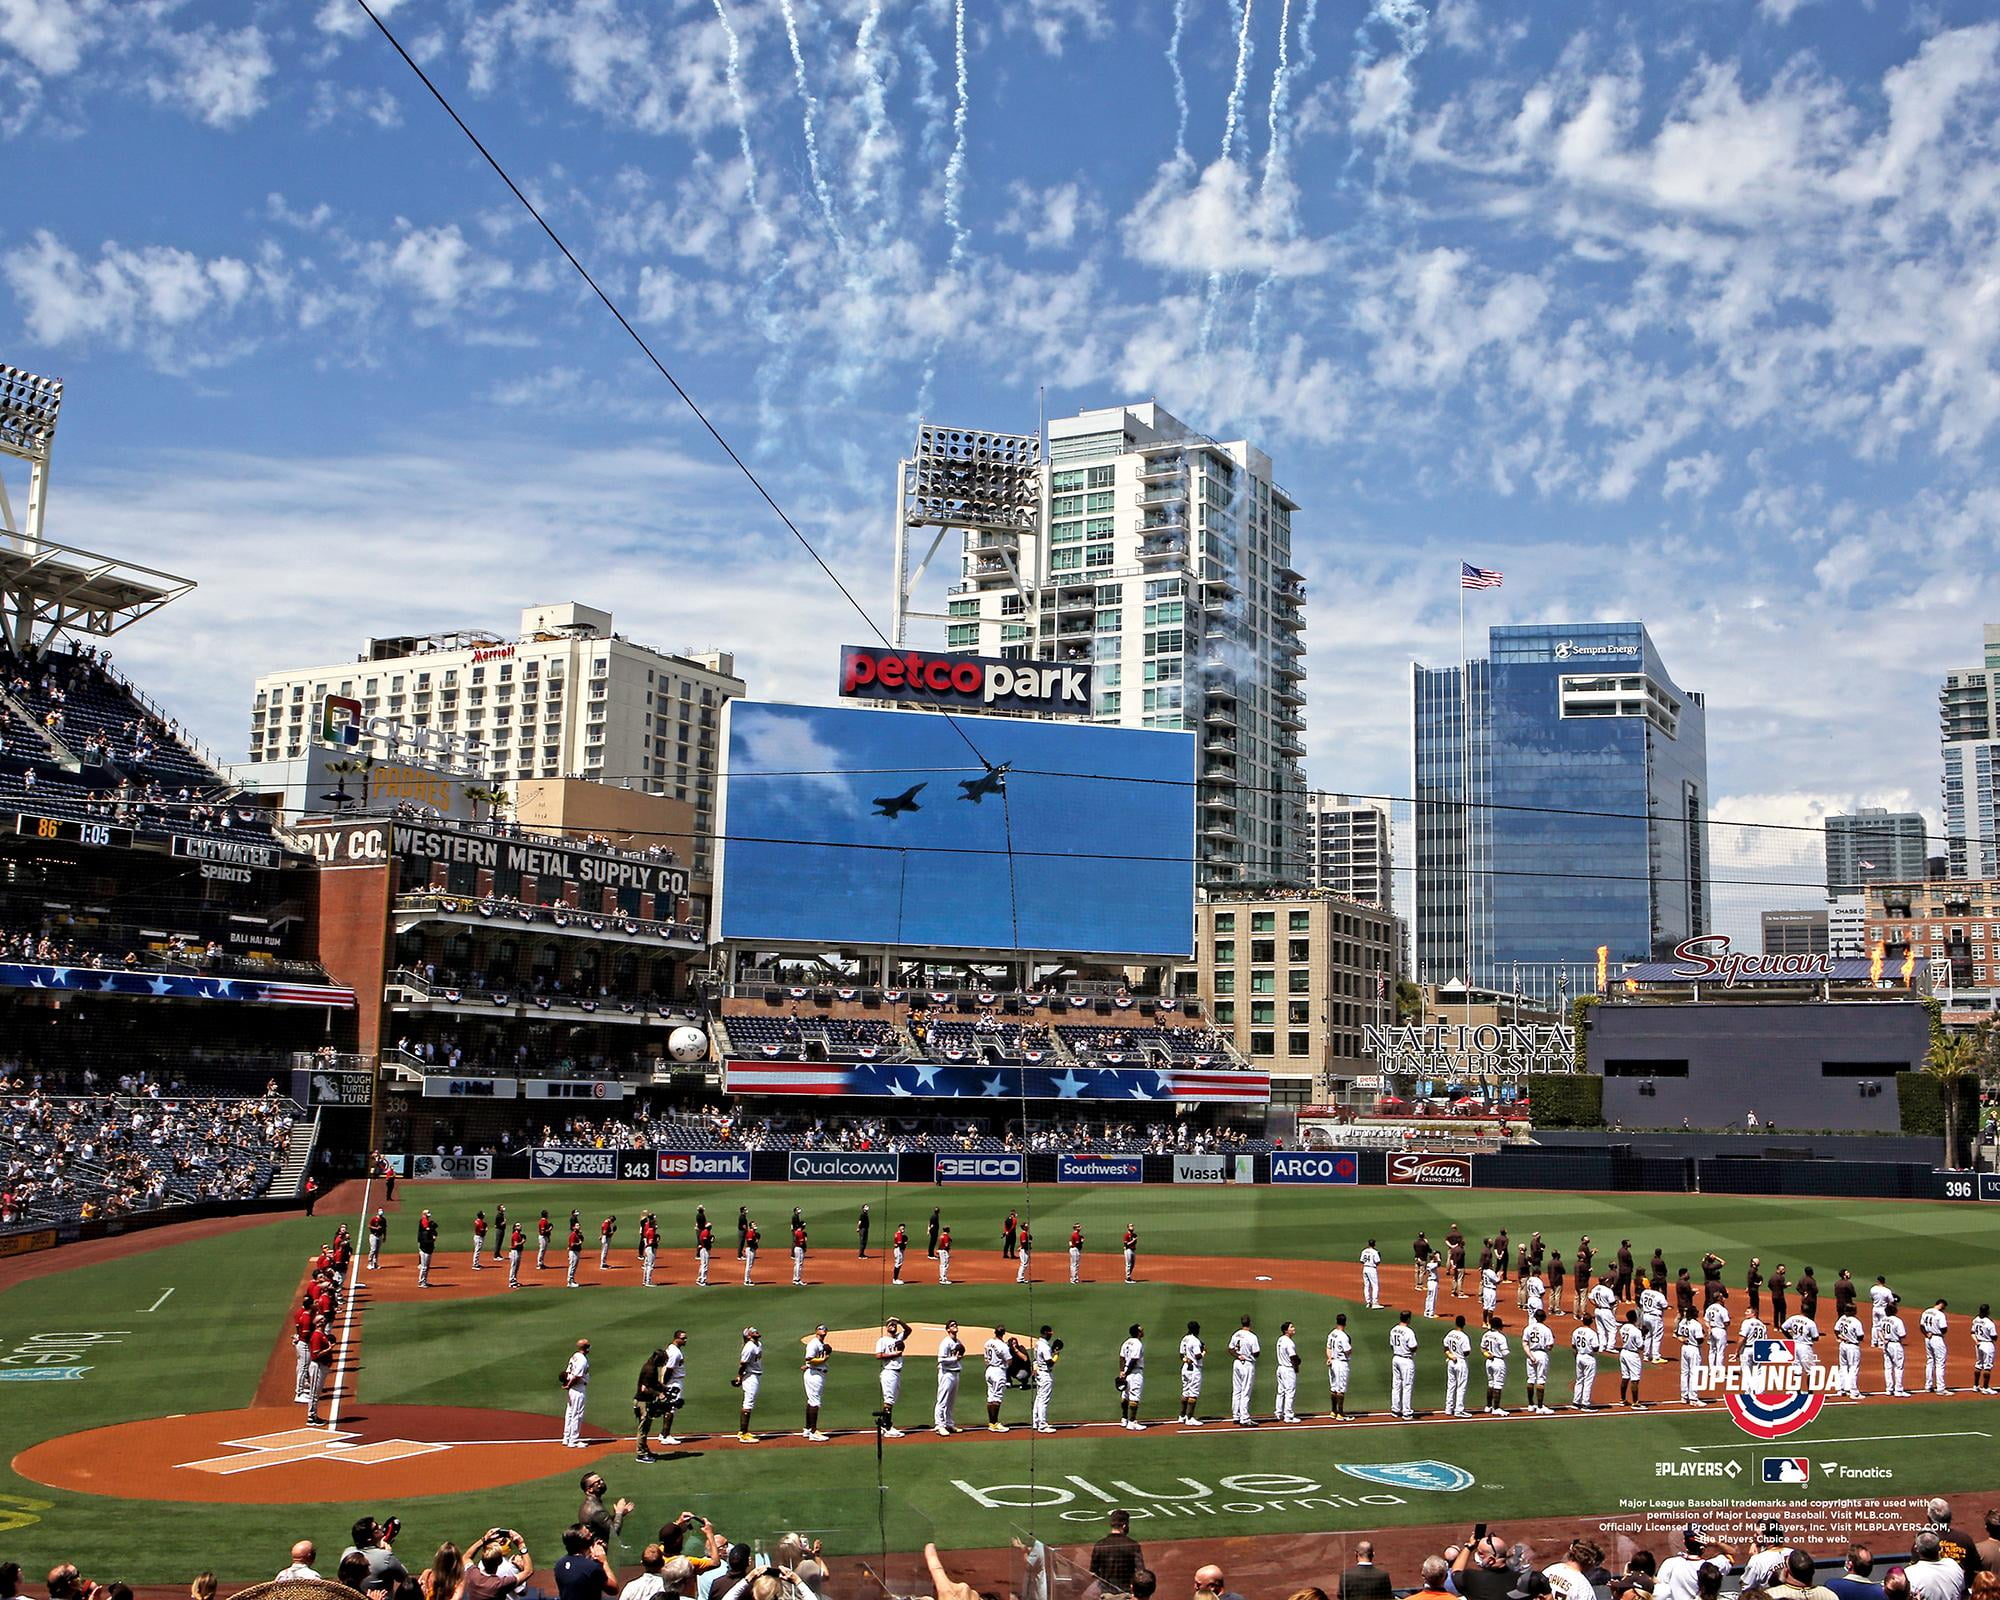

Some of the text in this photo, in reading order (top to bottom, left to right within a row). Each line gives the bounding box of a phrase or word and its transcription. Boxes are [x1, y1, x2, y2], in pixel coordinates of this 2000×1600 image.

[472, 646, 515, 663] Marriott
[1573, 645, 1639, 656] Sempra Energy
[372, 766, 450, 812] PADRES
[80, 823, 110, 845] 1:05
[186, 837, 271, 867] CUTWATER
[349, 829, 387, 861] CO.
[393, 826, 688, 896] WESTERN METAL SUPPLY CO.
[200, 864, 252, 884] SPIRITS
[230, 932, 248, 943] BALI
[264, 935, 281, 946] RUM
[1672, 934, 1835, 989] Sycuan
[1381, 1053, 1576, 1076] UNIVERSITY
[342, 1074, 372, 1085] TOUGH
[342, 1085, 371, 1094] TURTLE
[341, 1094, 370, 1103] TURF
[441, 1158, 488, 1171] ORIS
[564, 1154, 613, 1164] ROCKET
[794, 1158, 895, 1176] Qualcomm
[564, 1164, 614, 1174] LEAGUE
[624, 1162, 650, 1178] 343
[941, 1159, 1020, 1176] GEICO
[1064, 1161, 1129, 1176] Southwest
[1180, 1167, 1226, 1180] Viasat
[1273, 1159, 1334, 1176] ARCO
[1393, 1156, 1463, 1183] Sycuan
[1946, 1181, 1972, 1197] 396
[1882, 1323, 1891, 1335] 40
[1923, 1316, 1933, 1327] 44
[1530, 1332, 1540, 1344] 25
[1793, 1325, 1804, 1337] 34
[1576, 1336, 1586, 1348] 26
[950, 1473, 1323, 1508] blue
[1059, 1493, 1408, 1522] california
[1548, 1573, 1572, 1592] DAVIES
